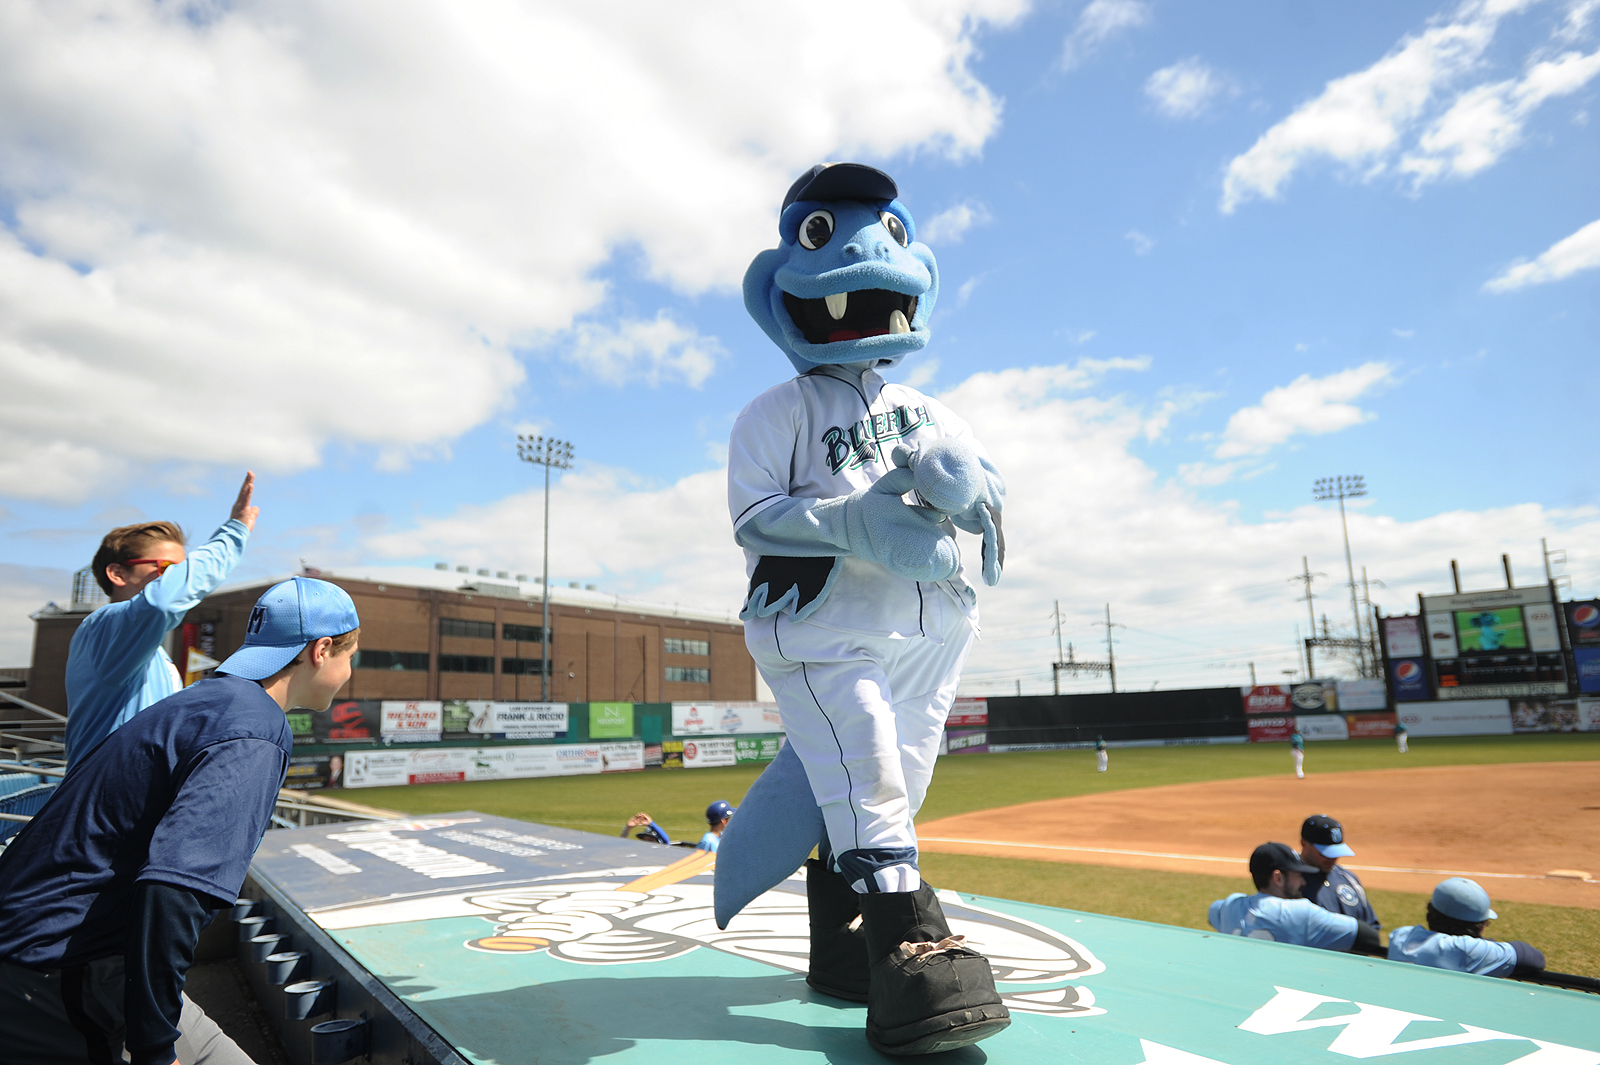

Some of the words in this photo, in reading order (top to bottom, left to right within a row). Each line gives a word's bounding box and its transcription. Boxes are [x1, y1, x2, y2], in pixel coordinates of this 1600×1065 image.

[821, 404, 935, 476] BLUEFIH
[1248, 695, 1286, 707] EDGE
[497, 712, 526, 721] FRANK
[537, 712, 565, 721] RICCIO
[1250, 717, 1286, 728] DATTCO
